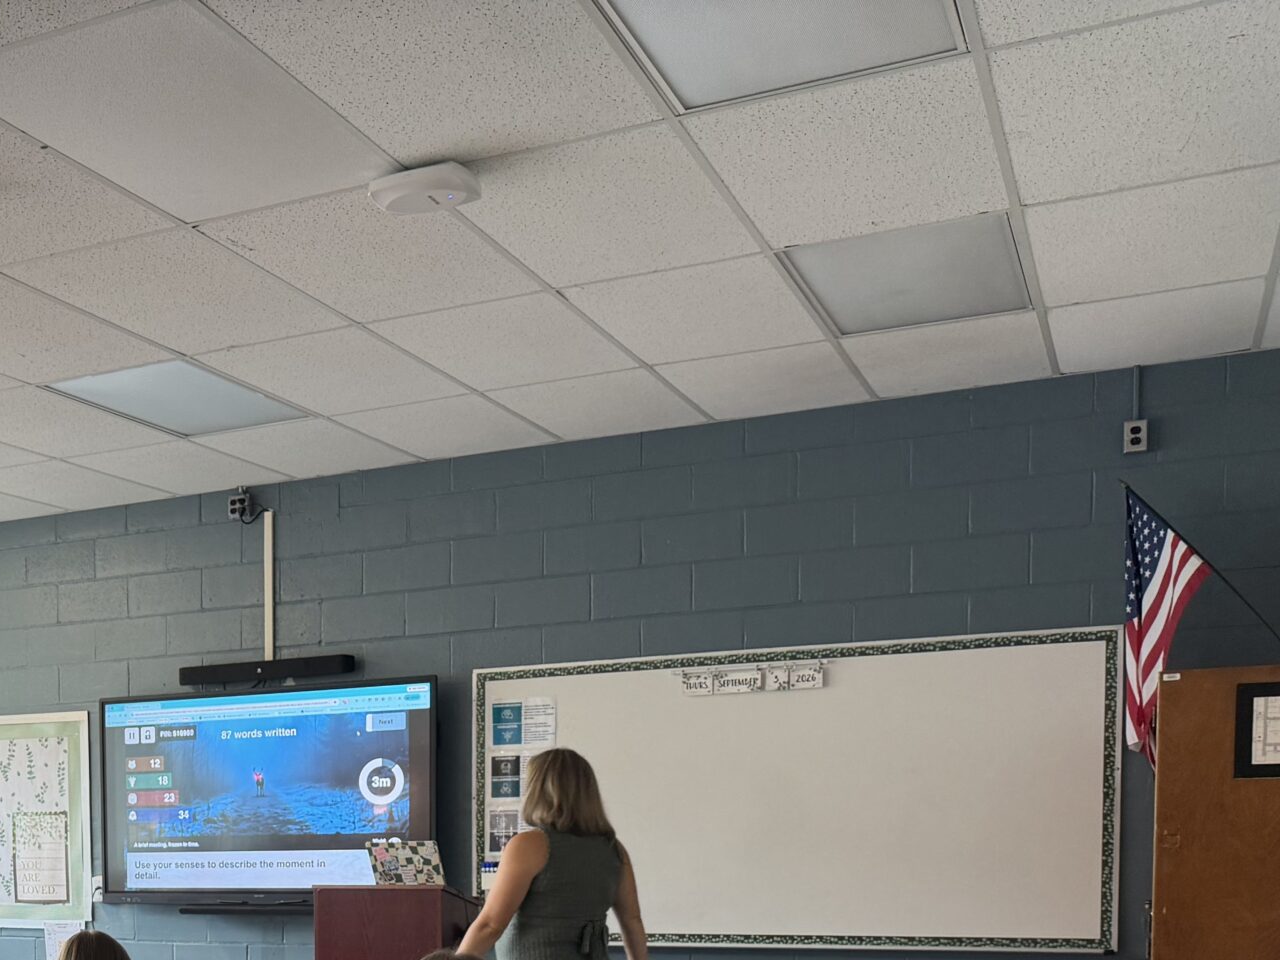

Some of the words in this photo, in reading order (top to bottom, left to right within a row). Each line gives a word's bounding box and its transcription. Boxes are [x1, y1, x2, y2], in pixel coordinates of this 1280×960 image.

[795, 673, 817, 683] 2026
[221, 730, 232, 740] 87
[234, 729, 262, 739] words
[265, 728, 297, 738] written
[149, 759, 160, 768] 12
[158, 775, 169, 785] 18
[371, 776, 391, 788] 3m
[163, 793, 175, 803] 23
[178, 810, 190, 819] 34
[21, 860, 41, 870] YOU
[134, 861, 151, 869] Use
[153, 862, 172, 871] your
[175, 861, 205, 869] senses
[207, 860, 216, 868] to
[219, 859, 257, 868] describe
[259, 859, 274, 868] the
[276, 860, 314, 868] moment
[317, 859, 326, 868] in
[22, 873, 40, 882] ARE
[134, 871, 161, 879] detail.
[22, 885, 58, 895] LOVED.
